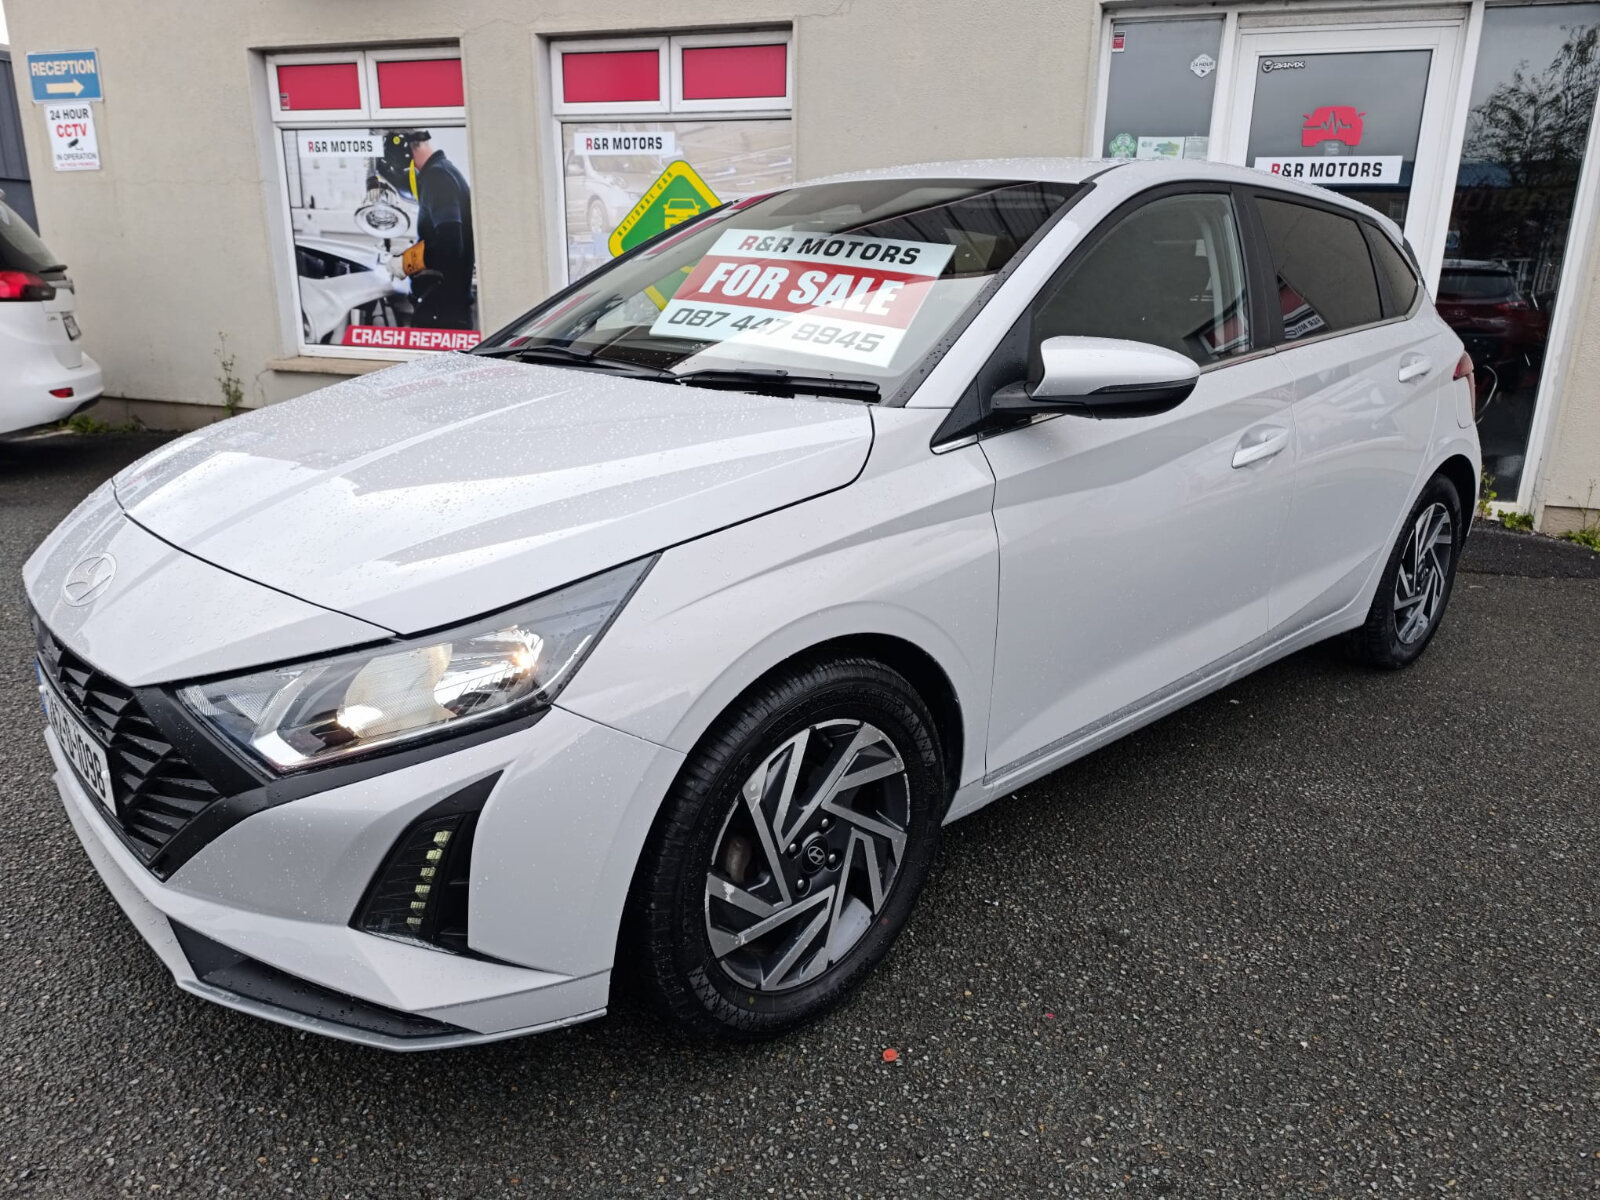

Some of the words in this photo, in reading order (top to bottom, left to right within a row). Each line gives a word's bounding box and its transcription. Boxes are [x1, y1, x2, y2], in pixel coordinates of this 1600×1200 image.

[30, 59, 96, 76] RECEPTION
[1273, 61, 1306, 69] 24MX
[49, 110, 60, 121] 24
[63, 108, 90, 120] HOUR
[56, 123, 87, 138] CCTV
[307, 141, 328, 153] R&R
[330, 141, 374, 153] MOTORS
[585, 137, 609, 150] R&R
[612, 136, 663, 150] MOTORS
[63, 152, 97, 161] OPERATION
[1270, 163, 1304, 178] R&R
[1309, 162, 1384, 178] MOTORS
[738, 235, 795, 253] R&R
[796, 237, 921, 265] MOTORS
[698, 262, 790, 301] FOR
[787, 270, 906, 317] SALE
[667, 307, 732, 329] 087
[791, 323, 885, 353] 9945
[351, 328, 405, 346] CRASH
[409, 331, 480, 350] REPAIRS
